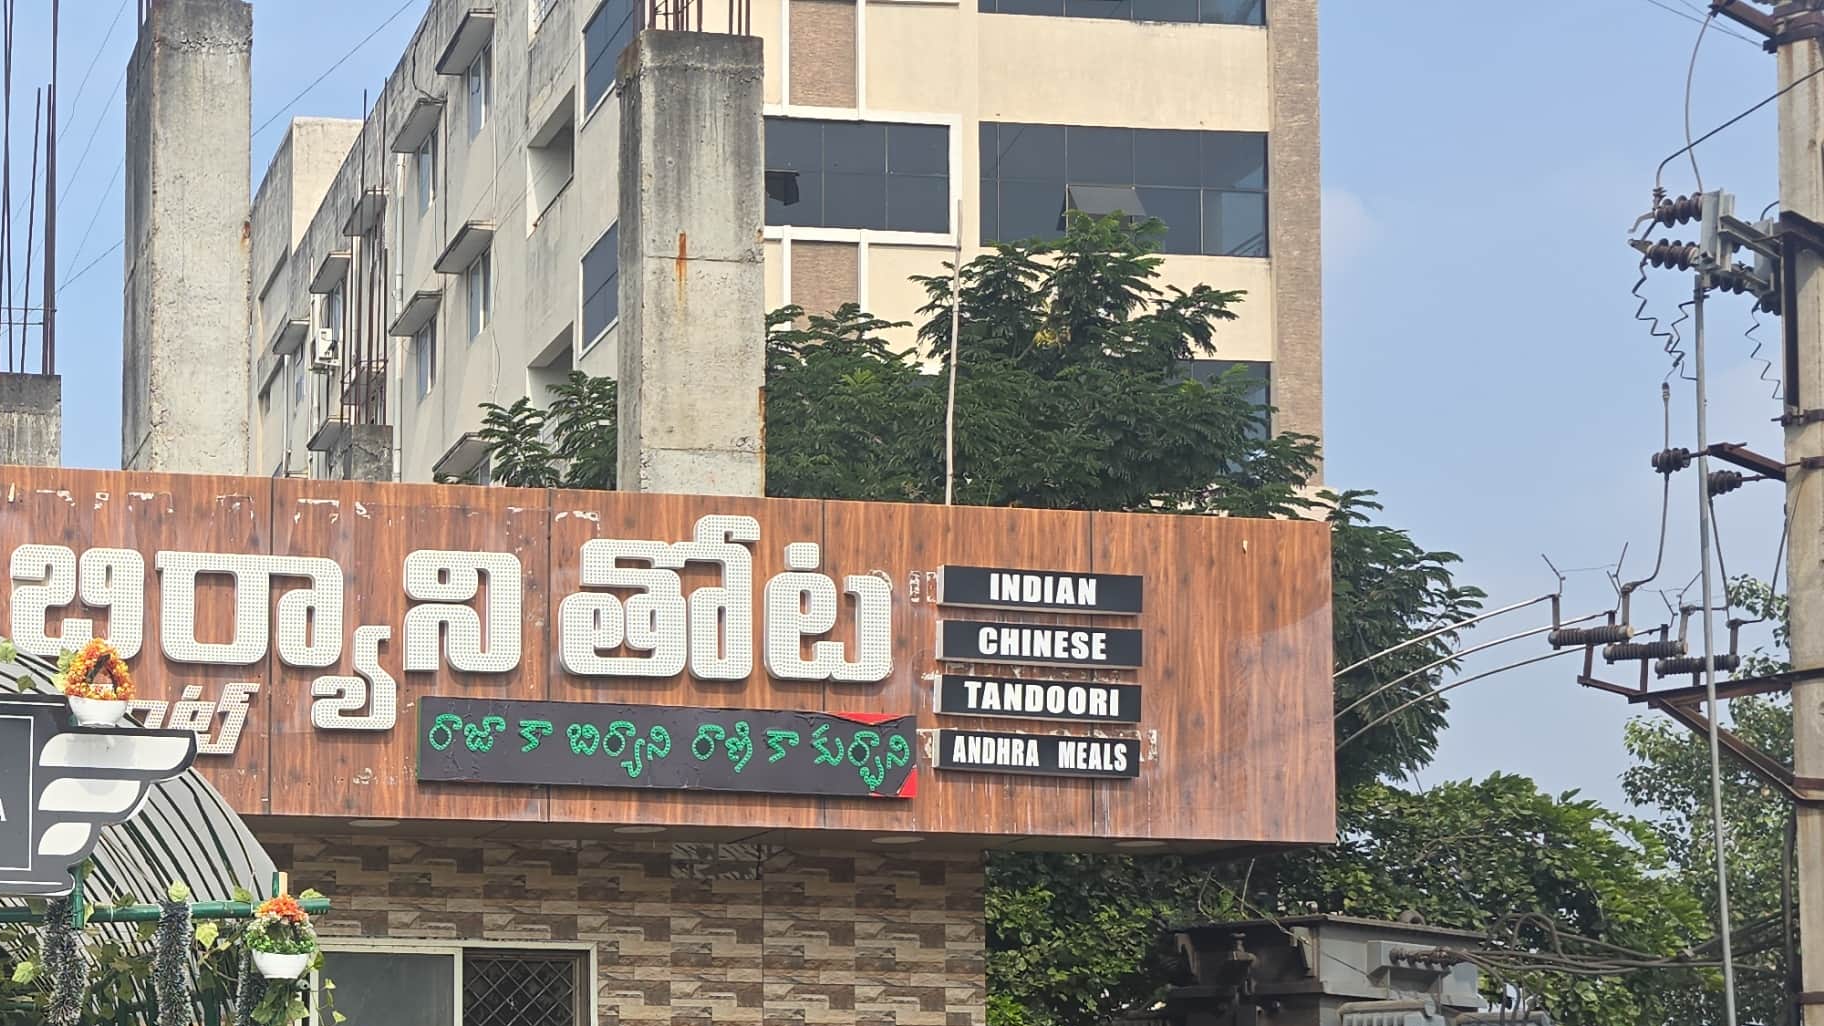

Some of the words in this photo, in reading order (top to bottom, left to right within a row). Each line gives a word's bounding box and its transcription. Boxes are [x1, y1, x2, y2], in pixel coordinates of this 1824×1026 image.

[557, 513, 895, 683] తోట
[988, 571, 1099, 607] INDIAN
[977, 626, 1108, 661] CHINESE
[963, 680, 1120, 717] TANDOORI
[518, 719, 555, 753] కా
[766, 729, 801, 764] కా
[951, 735, 1040, 768] ANDHRA
[1057, 740, 1129, 772] MEALS
